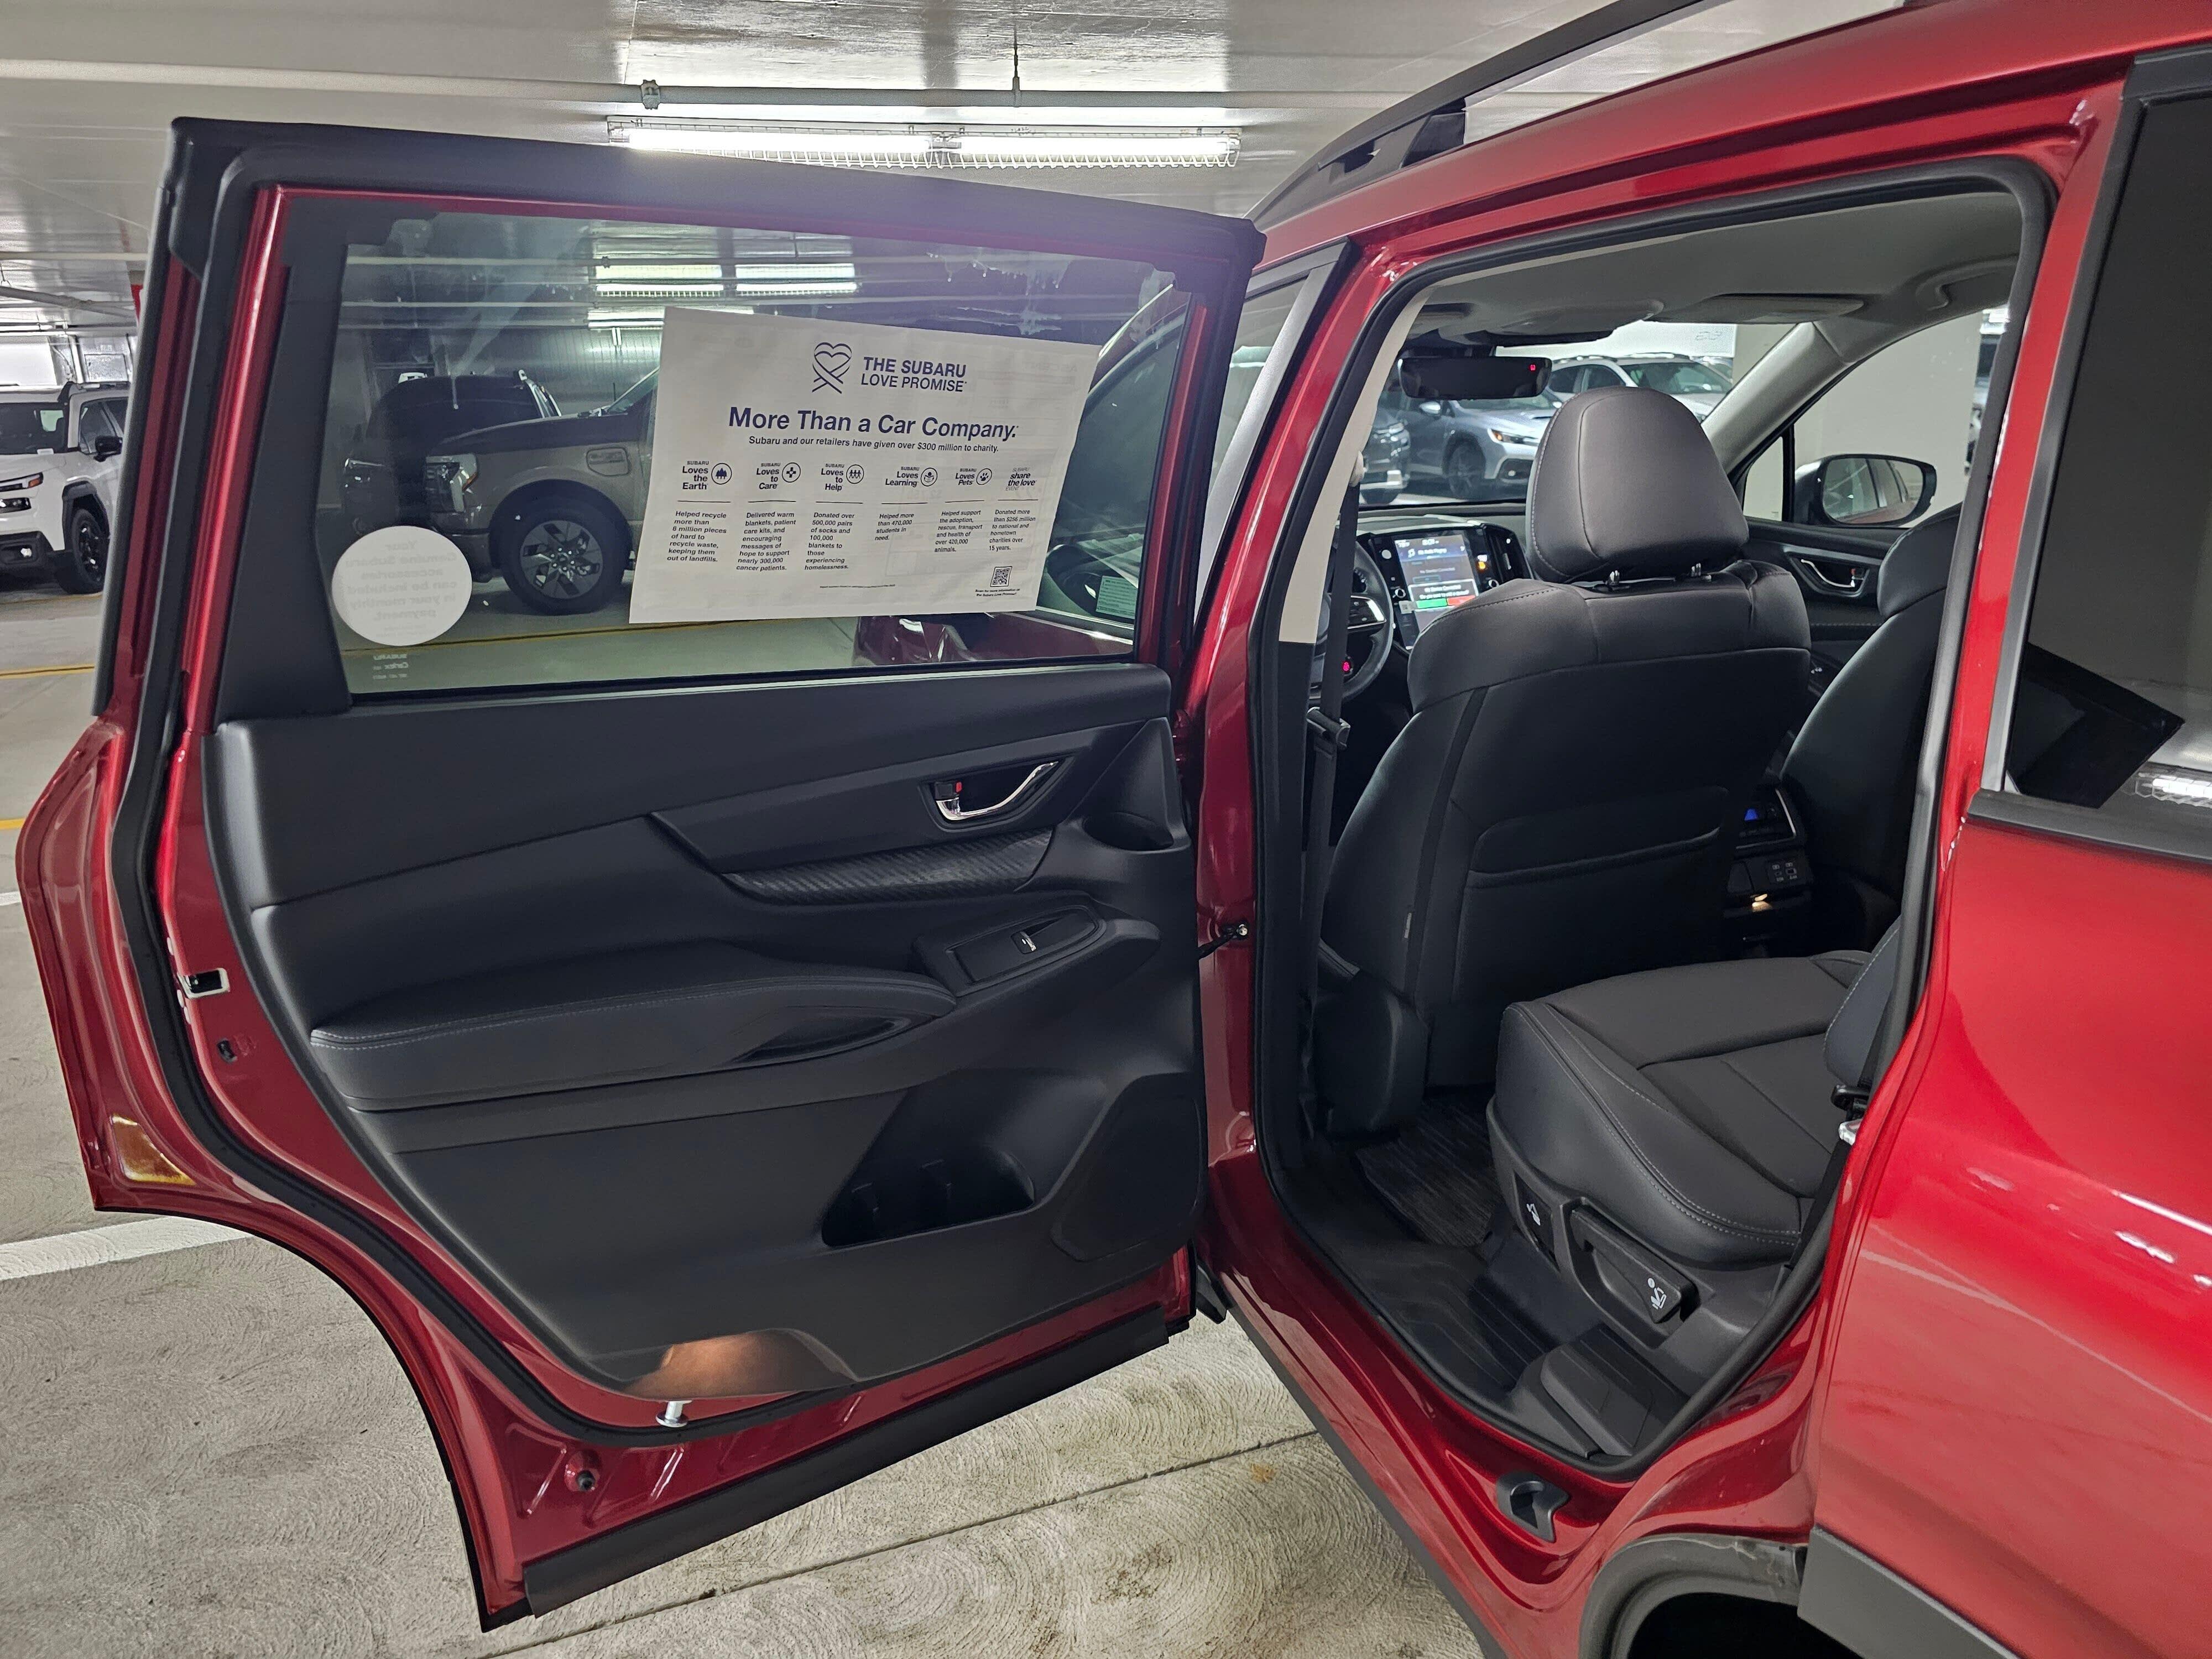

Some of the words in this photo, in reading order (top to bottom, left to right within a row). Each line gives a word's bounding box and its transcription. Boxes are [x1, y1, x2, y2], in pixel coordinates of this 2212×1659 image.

[864, 357, 896, 373] THE
[901, 360, 966, 378] SUBARU
[861, 373, 898, 387] LOVE
[901, 377, 964, 392] PROMISE
[729, 407, 789, 429] More
[797, 410, 851, 431] Than
[858, 419, 870, 432] a
[878, 415, 916, 434] Car
[922, 418, 1015, 441] Company.
[749, 436, 780, 444] Subaru
[973, 445, 998, 453] charity.
[825, 483, 842, 492] Help
[885, 478, 919, 487] Learning
